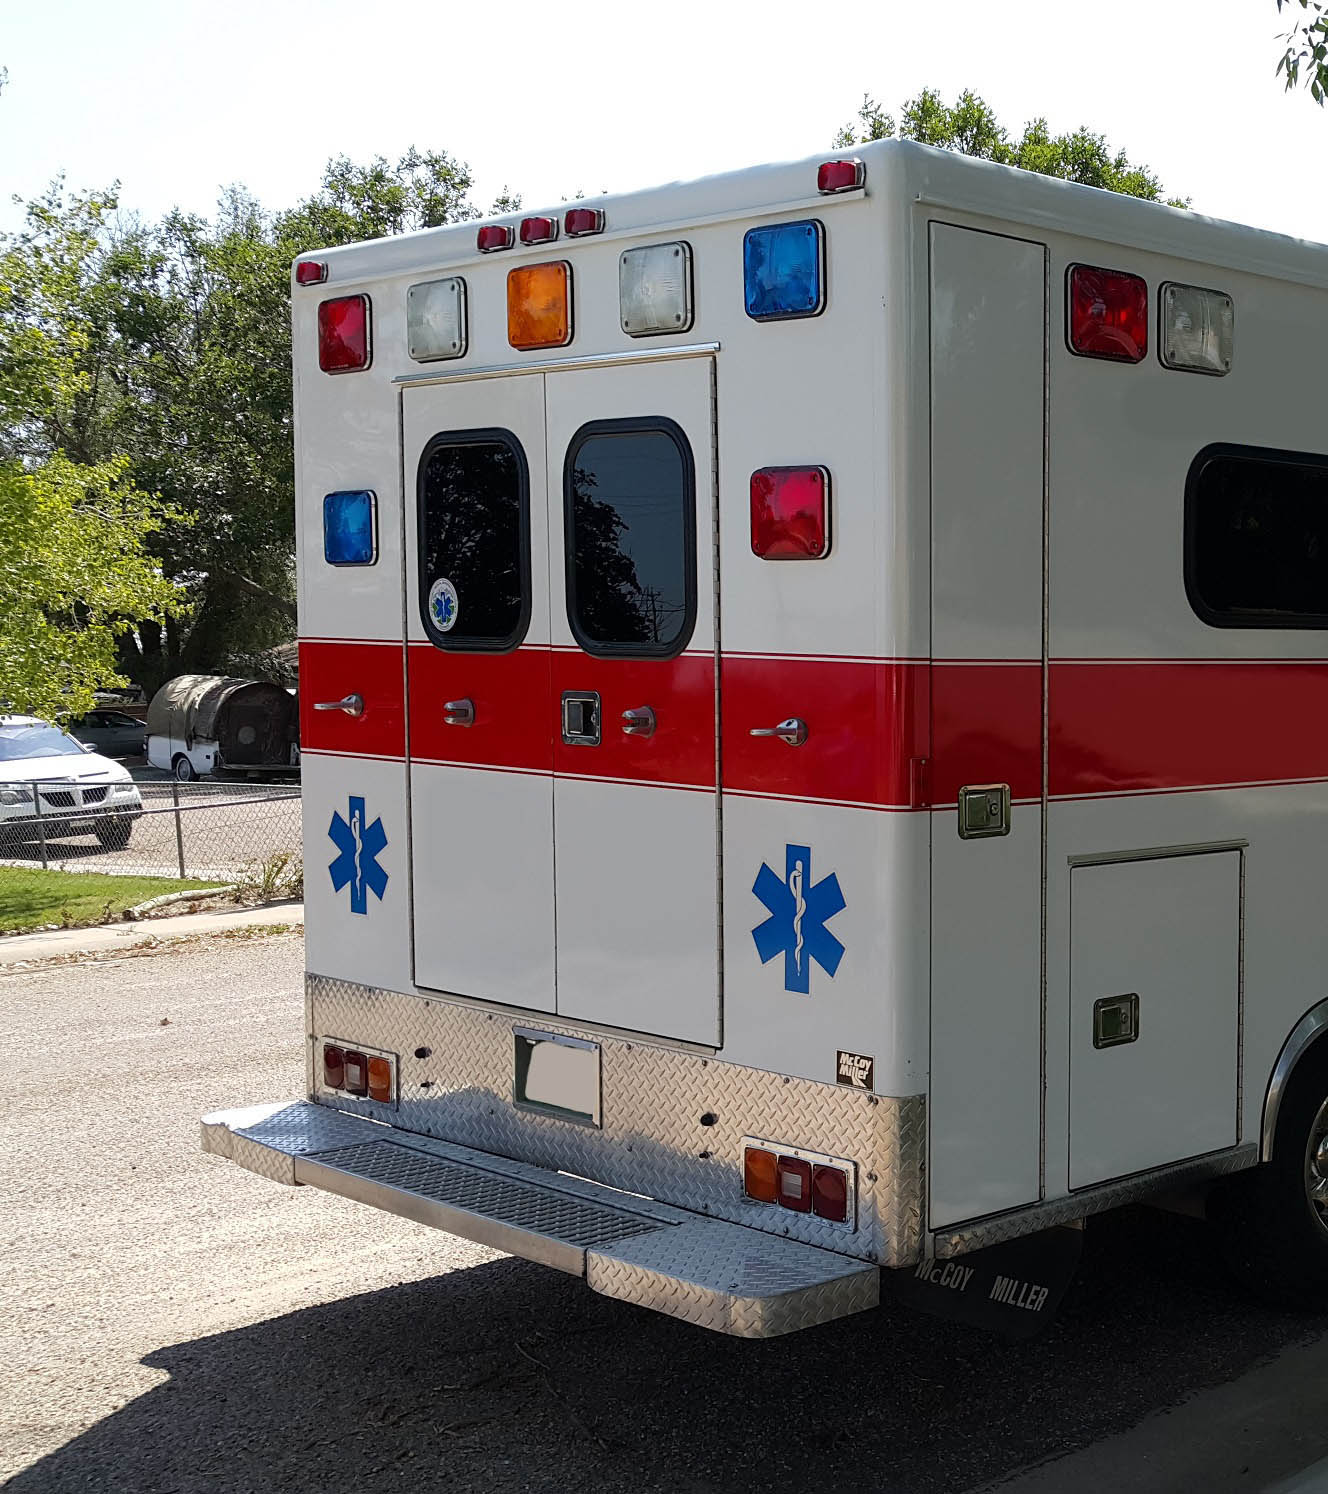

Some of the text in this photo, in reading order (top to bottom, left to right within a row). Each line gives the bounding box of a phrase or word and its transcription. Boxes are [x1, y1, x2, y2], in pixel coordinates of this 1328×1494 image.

[839, 1052, 872, 1071] McCoy
[839, 1063, 869, 1087] Miller
[914, 1258, 1049, 1312] McCOY MILLER
